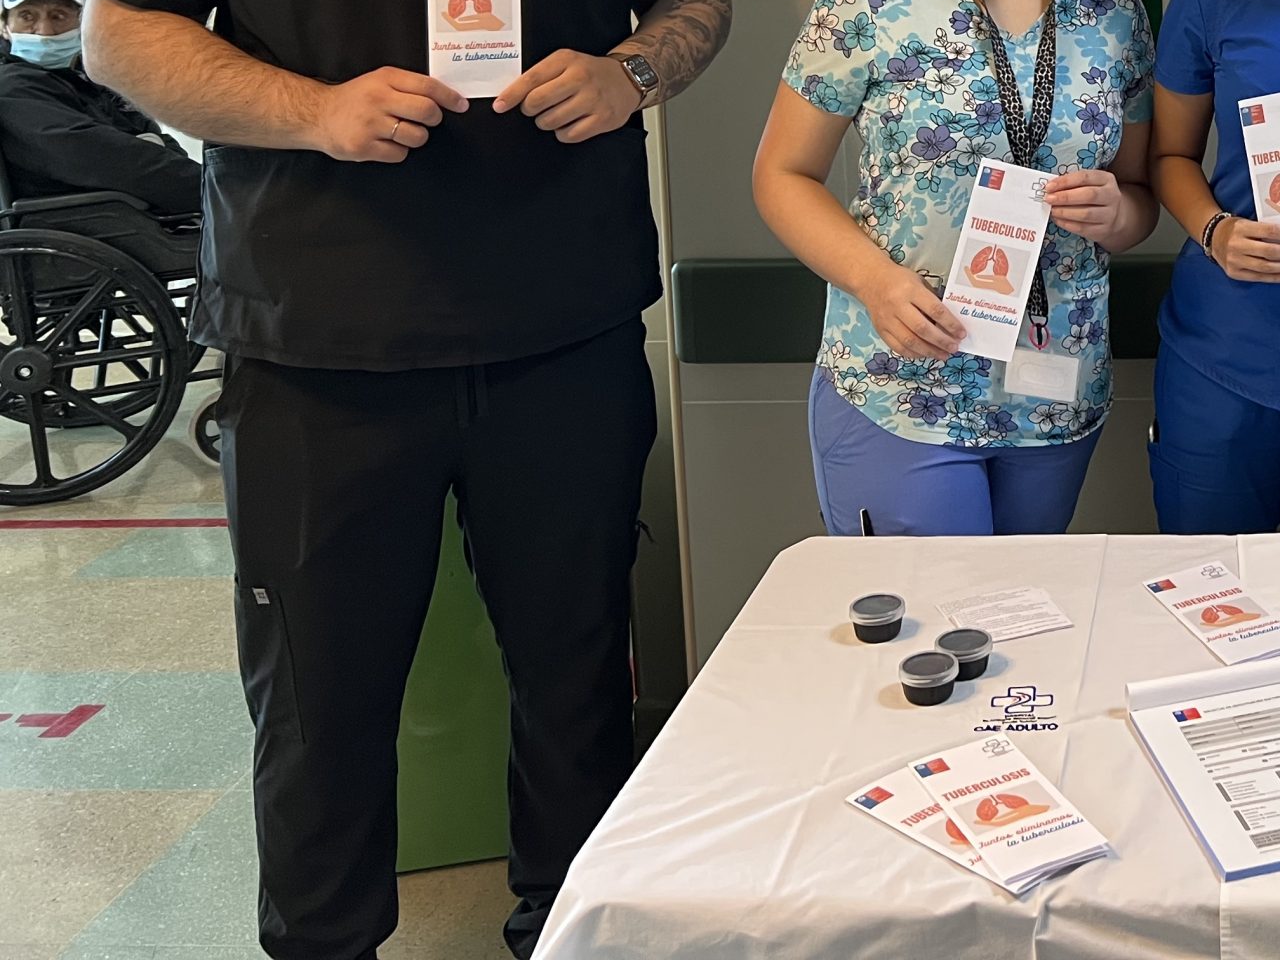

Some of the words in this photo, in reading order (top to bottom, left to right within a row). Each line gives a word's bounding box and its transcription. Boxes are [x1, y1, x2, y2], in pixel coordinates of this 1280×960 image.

[432, 42, 464, 51] Juntos
[465, 41, 516, 50] eliminamos
[452, 52, 463, 62] la
[971, 217, 1037, 242] TUBERCULOSIS
[946, 292, 972, 305] Juntos
[974, 299, 1017, 315] eliminamos
[960, 305, 969, 316] la
[1173, 587, 1242, 610] TUBERCULOSIS
[1006, 723, 1058, 731] ADULTO
[941, 768, 1031, 802] TUBERCULOSIS
[978, 833, 1014, 849] Juntos
[1016, 812, 1073, 835] eliminamos
[1007, 839, 1020, 848] la
